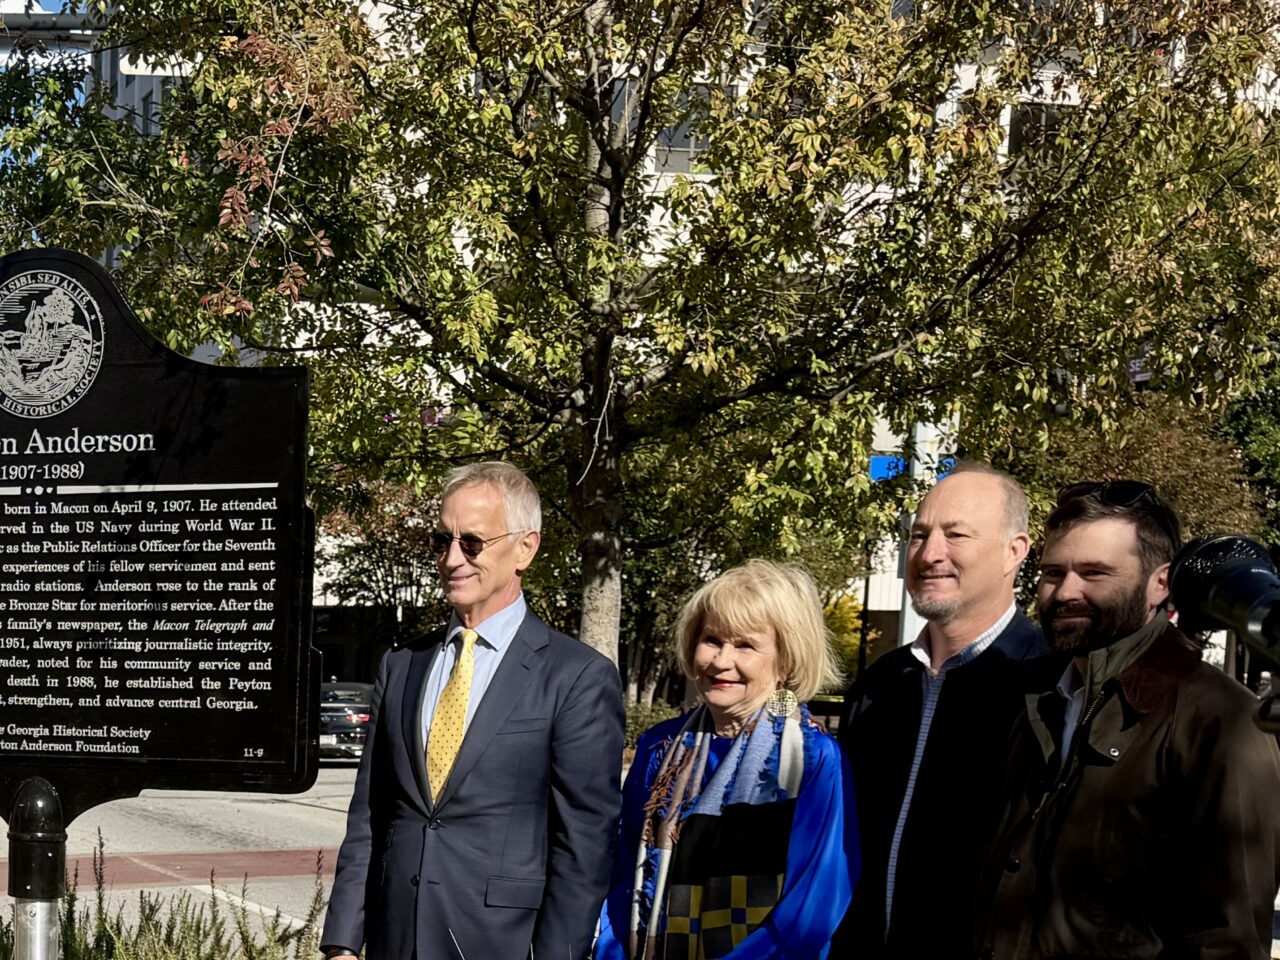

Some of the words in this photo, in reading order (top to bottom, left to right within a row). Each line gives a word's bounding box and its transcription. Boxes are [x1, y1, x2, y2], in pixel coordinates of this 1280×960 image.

[37, 273, 60, 285] SED
[3, 395, 76, 417] HISTORICAL
[75, 340, 103, 396] SOCIETY
[24, 427, 157, 454] Anderson
[4, 502, 31, 514] born
[34, 501, 47, 514] in
[50, 501, 89, 514] Macon
[93, 504, 109, 513] on
[111, 500, 142, 515] April
[146, 500, 157, 514] 9,
[163, 500, 194, 512] 1907.
[199, 499, 218, 511] He
[221, 497, 277, 511] attended
[31, 521, 44, 533] in
[49, 521, 69, 533] the
[75, 521, 94, 533] US
[100, 520, 132, 535] Navy
[138, 519, 180, 534] during
[185, 518, 223, 531] World
[228, 518, 255, 531] War
[261, 517, 276, 530] II.
[6, 544, 19, 553] as
[21, 541, 40, 553] the
[42, 540, 79, 552] Public
[81, 540, 137, 552] Relations
[139, 539, 181, 552] Officer
[182, 539, 200, 551] for
[202, 539, 223, 551] the
[224, 538, 276, 551] Seventh
[2, 560, 70, 574] experiences
[72, 560, 85, 572] of
[87, 560, 105, 572] his
[109, 559, 145, 572] fellow
[148, 559, 217, 571] servicemen
[220, 558, 244, 571] and
[248, 559, 275, 571] sent
[0, 579, 30, 591] radio
[34, 579, 84, 591] stations.
[94, 579, 151, 591] Anderson
[156, 582, 182, 591] rose
[186, 580, 199, 591] to
[203, 579, 223, 591] the
[228, 578, 257, 591] rank
[262, 578, 276, 590] of
[9, 598, 49, 610] Bronze
[51, 598, 78, 611] Star
[79, 599, 96, 610] for
[99, 599, 168, 611] meritorious
[170, 598, 216, 611] service.
[218, 598, 251, 611] After
[253, 598, 273, 611] the
[7, 617, 52, 632] family's
[57, 621, 123, 632] newspaper,
[127, 618, 148, 630] the
[152, 619, 189, 630] Macon
[194, 618, 247, 633] Telegraph
[252, 618, 275, 630] and
[0, 637, 29, 650] 1951,
[32, 636, 72, 651] always
[75, 637, 142, 652] prioritizing
[143, 637, 213, 652] journalistic
[216, 638, 272, 653] integrity.
[37, 656, 69, 668] noted
[76, 656, 93, 668] for
[99, 656, 118, 668] his
[124, 657, 191, 671] community
[198, 657, 240, 670] service
[248, 658, 272, 670] and
[6, 674, 40, 686] death
[46, 675, 58, 687] in
[66, 675, 96, 689] 1988,
[104, 675, 119, 688] he
[125, 676, 193, 689] established
[200, 677, 221, 689] the
[228, 677, 272, 691] Peyton
[7, 693, 73, 707] strengthen,
[78, 694, 100, 706] and
[105, 695, 154, 707] advance
[158, 696, 201, 708] central
[206, 696, 258, 711] Georgia.
[7, 724, 50, 737] Georgia
[53, 725, 108, 738] Historical
[110, 726, 151, 740] Society
[20, 740, 72, 752] Anderson
[75, 741, 140, 754] Foundation
[243, 748, 264, 757] 11-9
